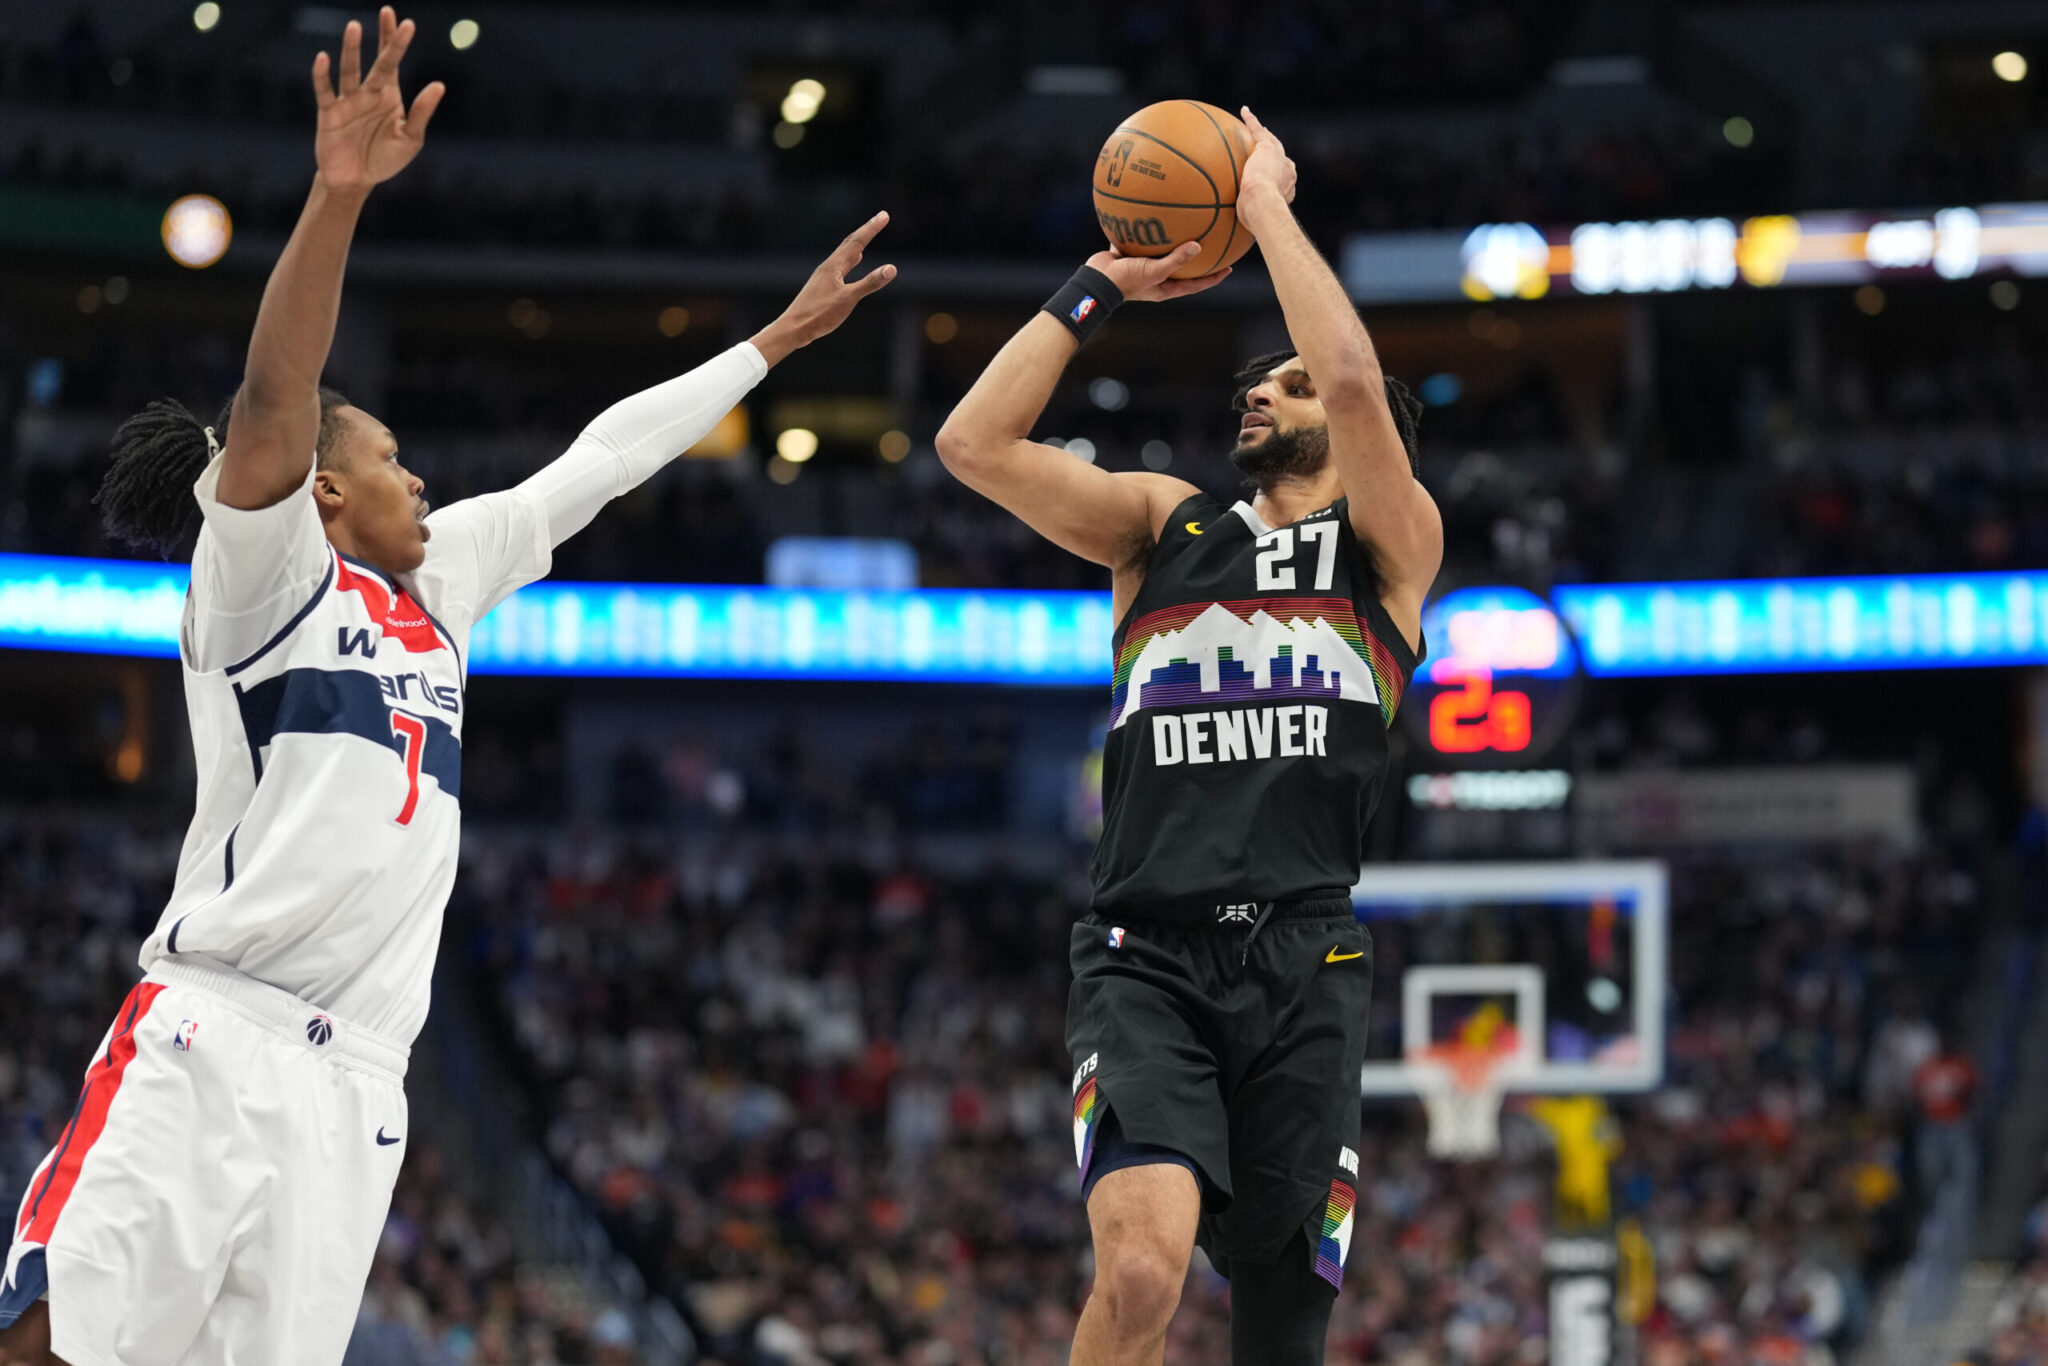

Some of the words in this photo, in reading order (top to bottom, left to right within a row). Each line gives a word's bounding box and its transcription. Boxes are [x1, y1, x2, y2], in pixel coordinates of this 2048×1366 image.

[1256, 519, 1339, 591] 27
[338, 625, 458, 715] Wards
[392, 711, 424, 827] 7
[1152, 704, 1329, 767] DENVER
